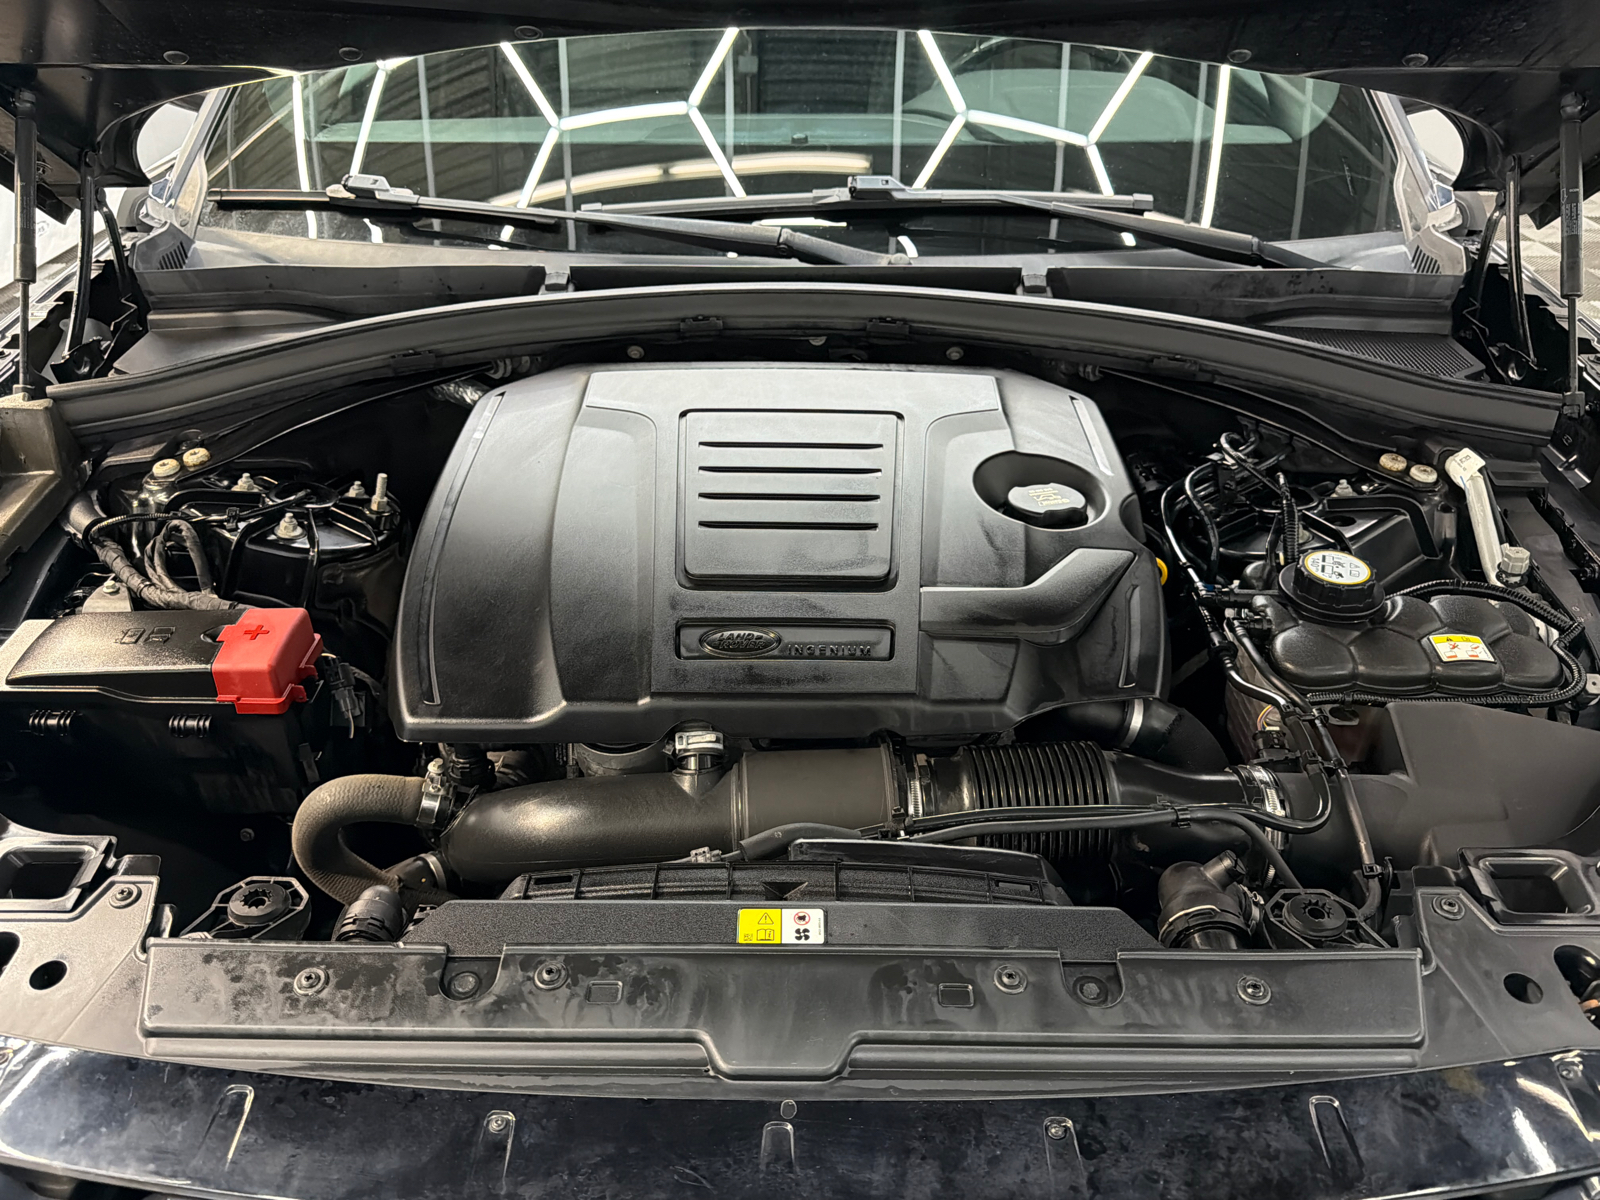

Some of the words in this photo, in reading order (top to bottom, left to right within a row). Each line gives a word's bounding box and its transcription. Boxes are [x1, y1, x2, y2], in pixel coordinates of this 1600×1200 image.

[717, 632, 755, 641] LAND
[718, 640, 766, 649] ROVER
[787, 644, 872, 656] INGENIUM
